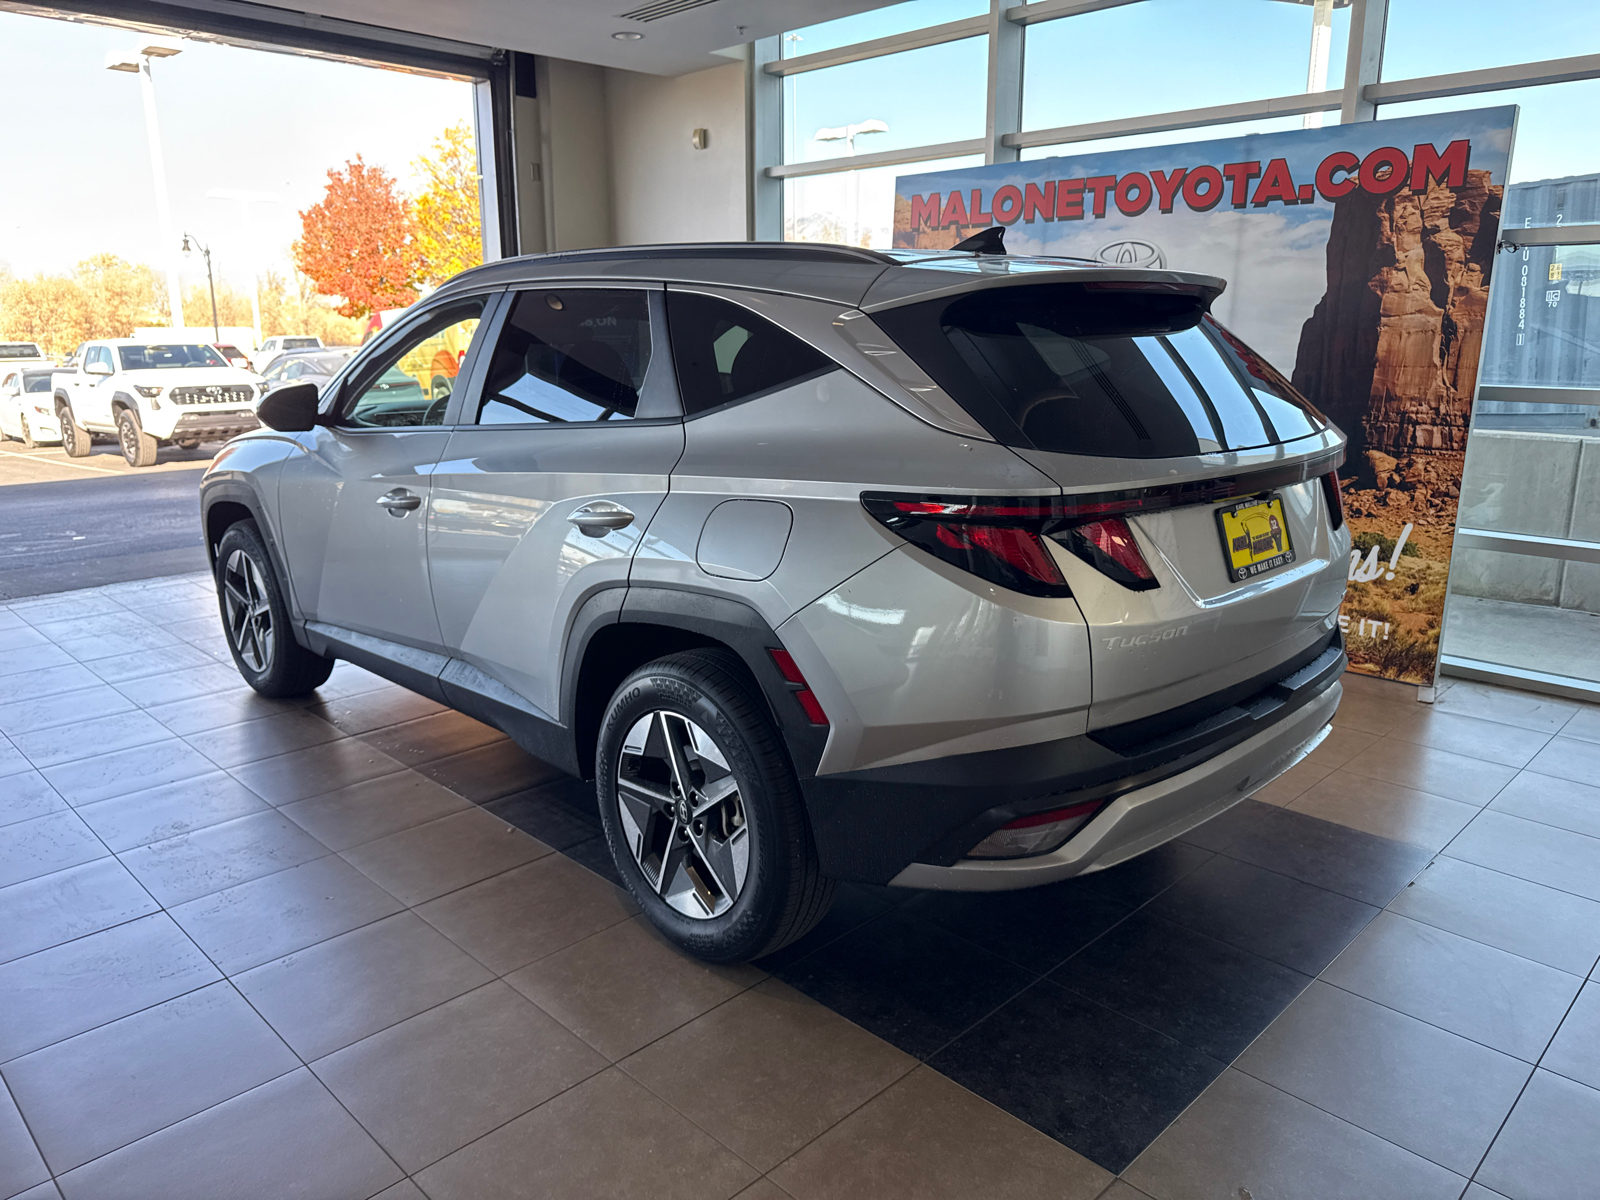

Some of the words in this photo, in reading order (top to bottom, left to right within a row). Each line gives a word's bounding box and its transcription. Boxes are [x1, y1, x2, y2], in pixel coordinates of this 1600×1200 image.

[911, 139, 1470, 231] MALONETOYOTA.COM
[1249, 566, 1258, 575] WE
[1257, 560, 1270, 572] MAKE
[1273, 555, 1284, 567] EASY
[1359, 618, 1391, 641] IT!
[606, 686, 641, 732] KUMHO
